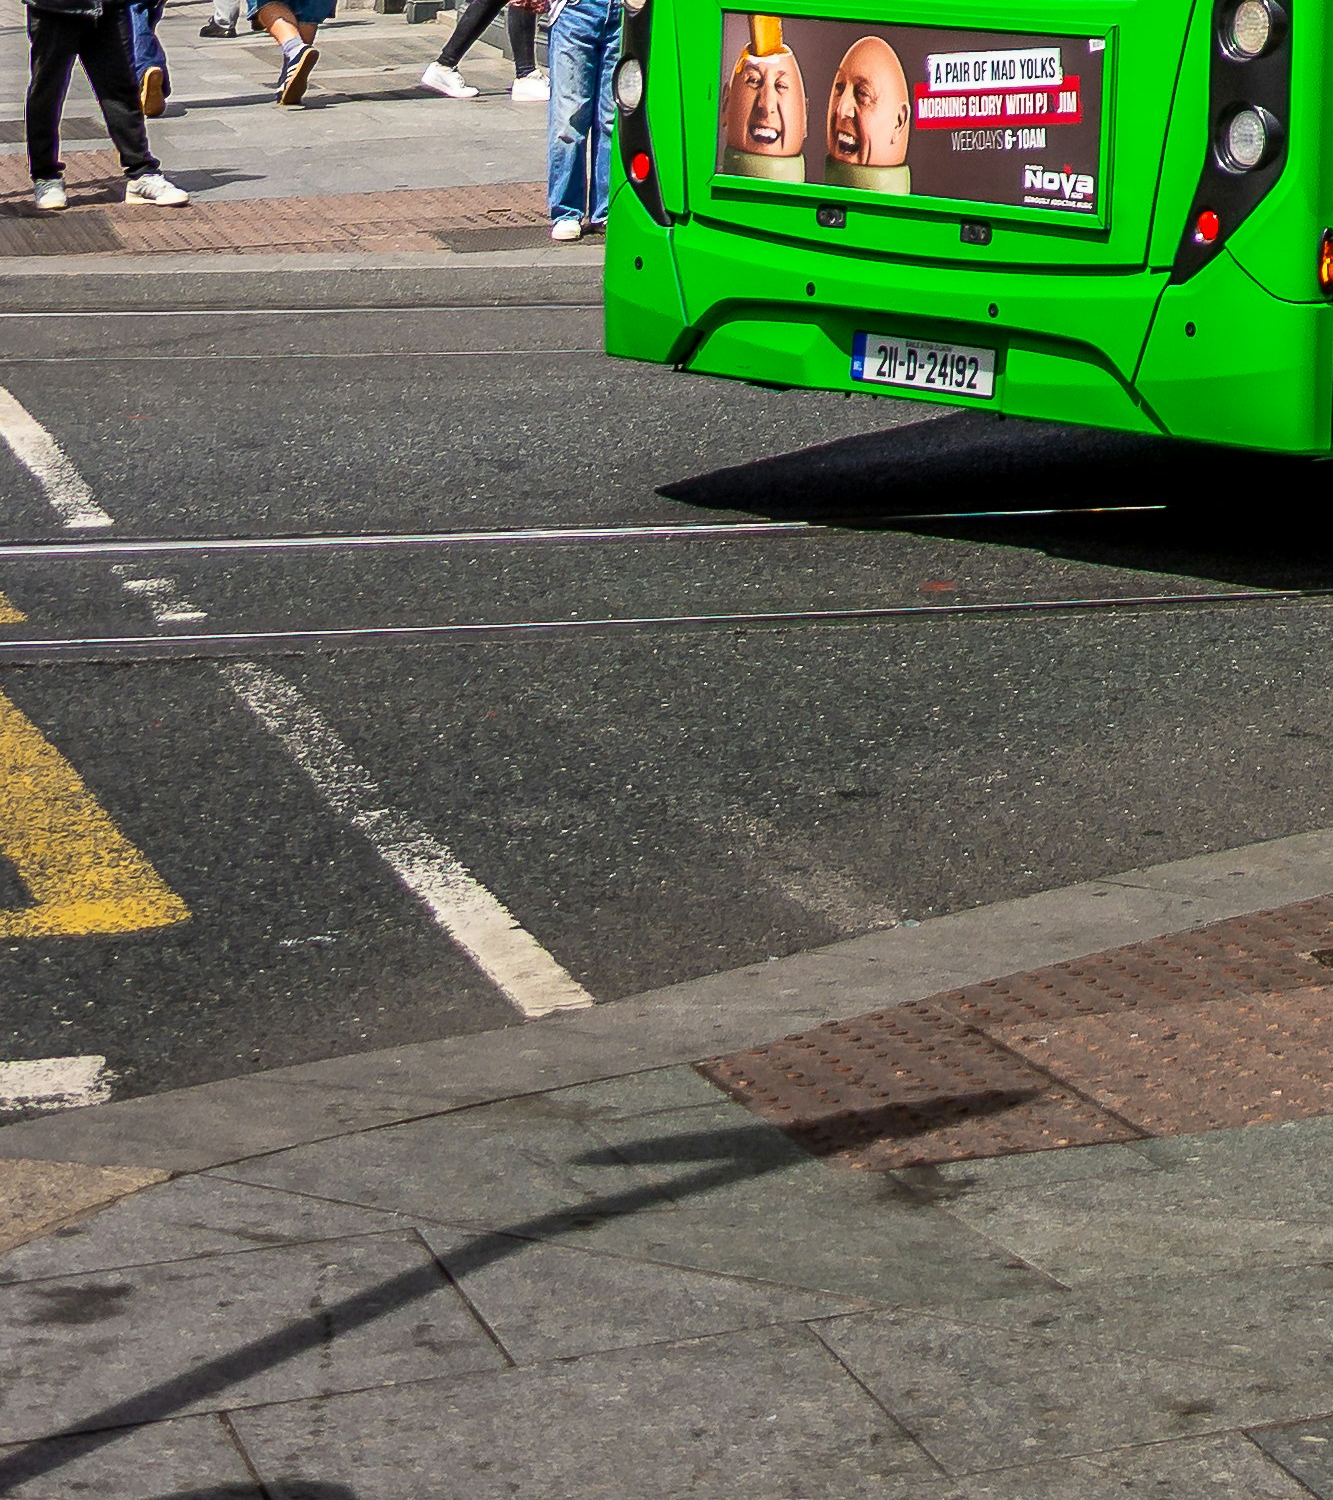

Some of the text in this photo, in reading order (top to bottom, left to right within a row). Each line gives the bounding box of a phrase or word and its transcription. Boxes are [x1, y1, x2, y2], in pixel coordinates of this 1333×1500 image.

[934, 56, 1056, 84] A PAIR OF MAD YOLKS
[917, 96, 967, 119] MORNING
[968, 94, 1004, 118] GLORY
[1005, 92, 1035, 116] WITH
[1035, 92, 1049, 114] PJ
[1057, 91, 1078, 114] JIM
[951, 127, 1047, 151] WEEKDAYS 6-10AM
[876, 344, 980, 390] 211-D-24192
